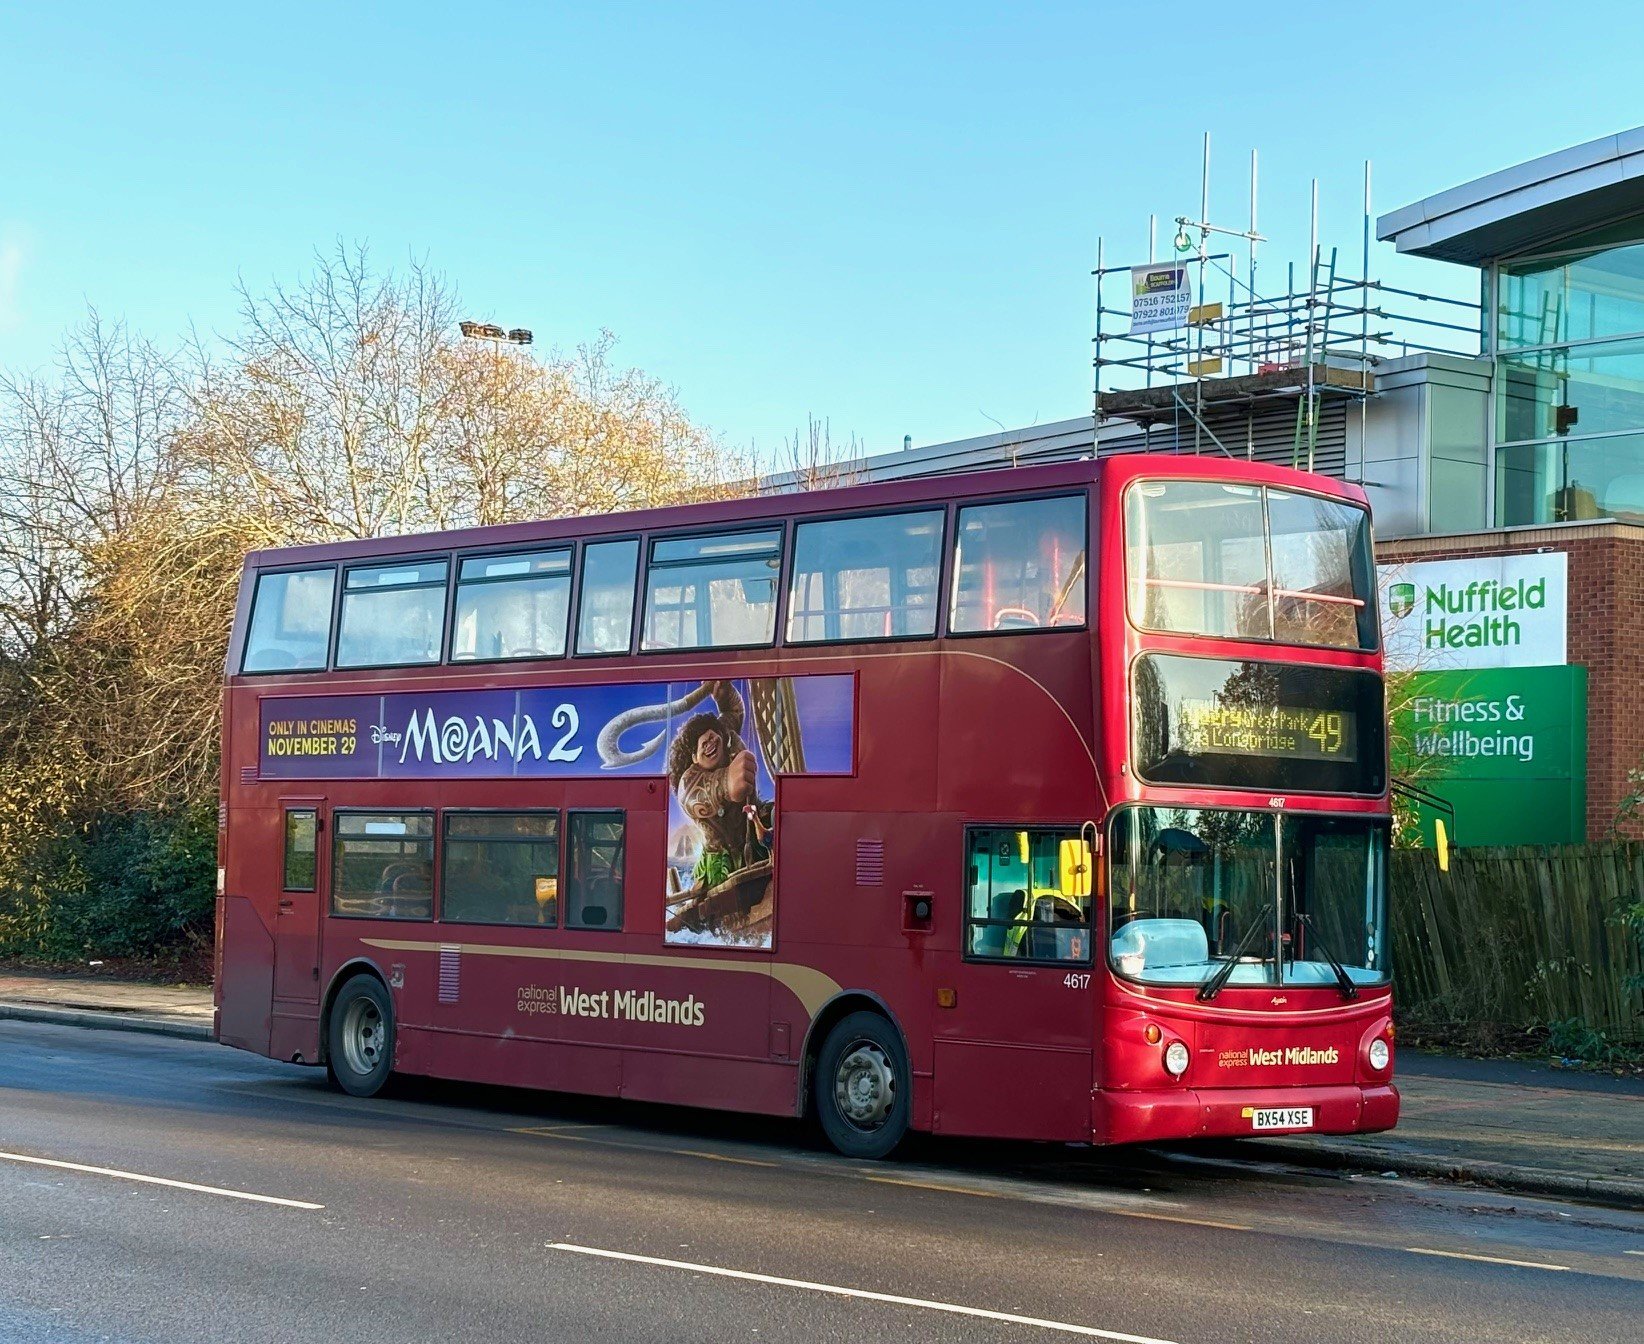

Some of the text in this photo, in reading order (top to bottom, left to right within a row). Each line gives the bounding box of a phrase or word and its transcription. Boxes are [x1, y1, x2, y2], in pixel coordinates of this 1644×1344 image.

[1133, 293, 1190, 307] 07516 752157
[1133, 309, 1158, 319] 07922
[1426, 577, 1546, 615] Nuffield
[1425, 614, 1521, 649] Health
[1414, 695, 1525, 723] Fitness &
[269, 718, 357, 736] ONLY IN CINEMAS
[1280, 711, 1309, 731] Park
[547, 703, 583, 762] 2
[1308, 713, 1343, 753] 49
[268, 736, 357, 756] NOVEMBER 29
[1415, 730, 1534, 762] Wellbeing
[1269, 797, 1286, 808] 4617
[1063, 973, 1091, 989] 4617
[517, 984, 558, 1000] national
[517, 1000, 558, 1016] express
[560, 985, 705, 1027] West Midlands
[1218, 1049, 1248, 1059] national
[1218, 1058, 1248, 1068] express
[1249, 1046, 1339, 1066] West Midlands
[1257, 1110, 1308, 1126] BX54 XSE
